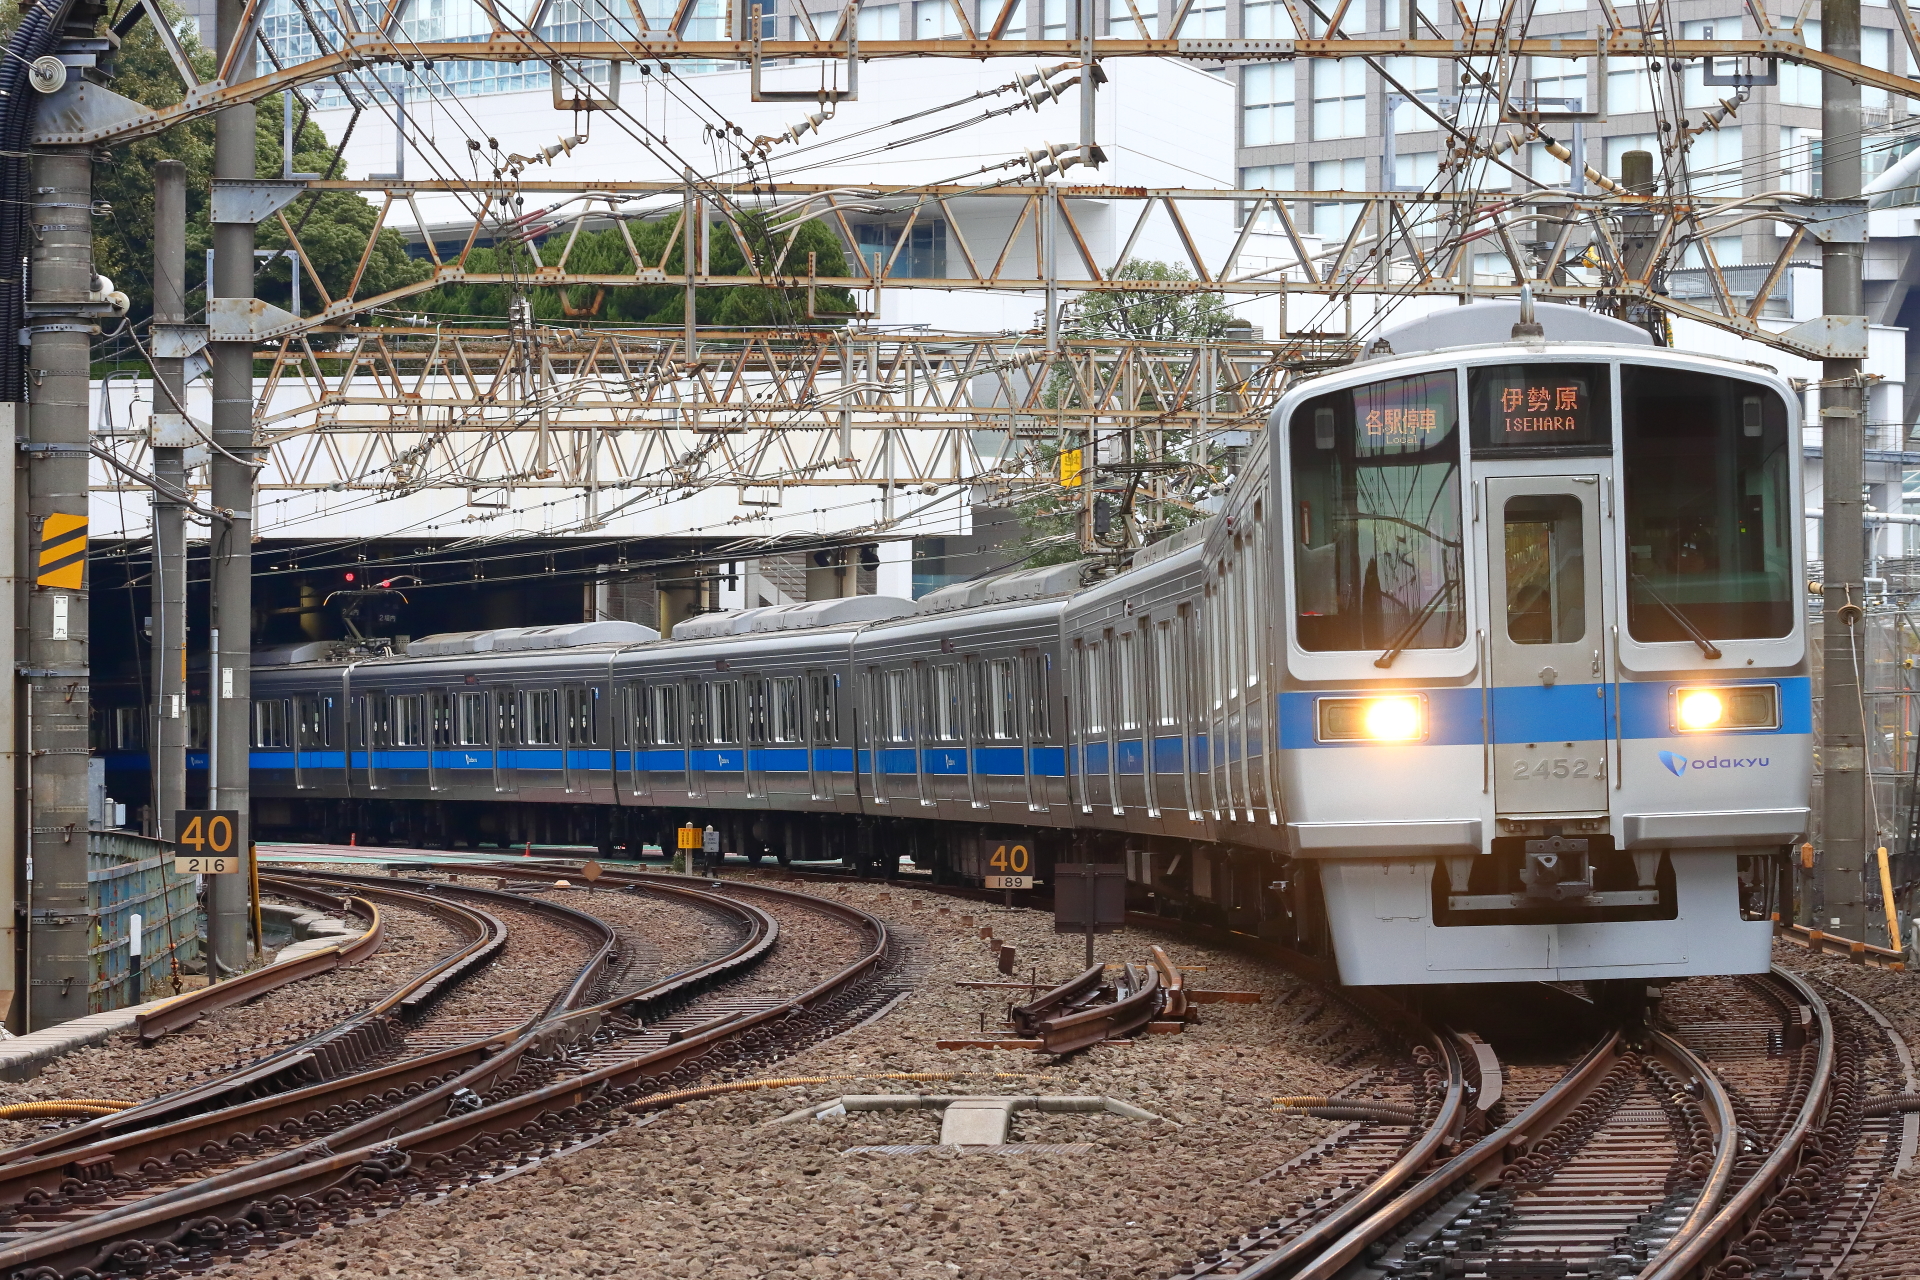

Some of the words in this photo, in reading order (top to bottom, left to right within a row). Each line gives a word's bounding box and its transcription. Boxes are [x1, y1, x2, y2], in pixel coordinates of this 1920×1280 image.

[1500, 386, 1578, 413] 伊勢原
[1365, 407, 1437, 436] 各駅停車
[1505, 416, 1575, 432] ISEHARA
[1386, 434, 1418, 445] Local
[1513, 757, 1590, 781] 2452
[1691, 755, 1770, 770] odakyu
[181, 815, 233, 852] 40
[188, 858, 225, 872] 216
[989, 844, 1029, 873] 40
[998, 876, 1023, 888] 189
